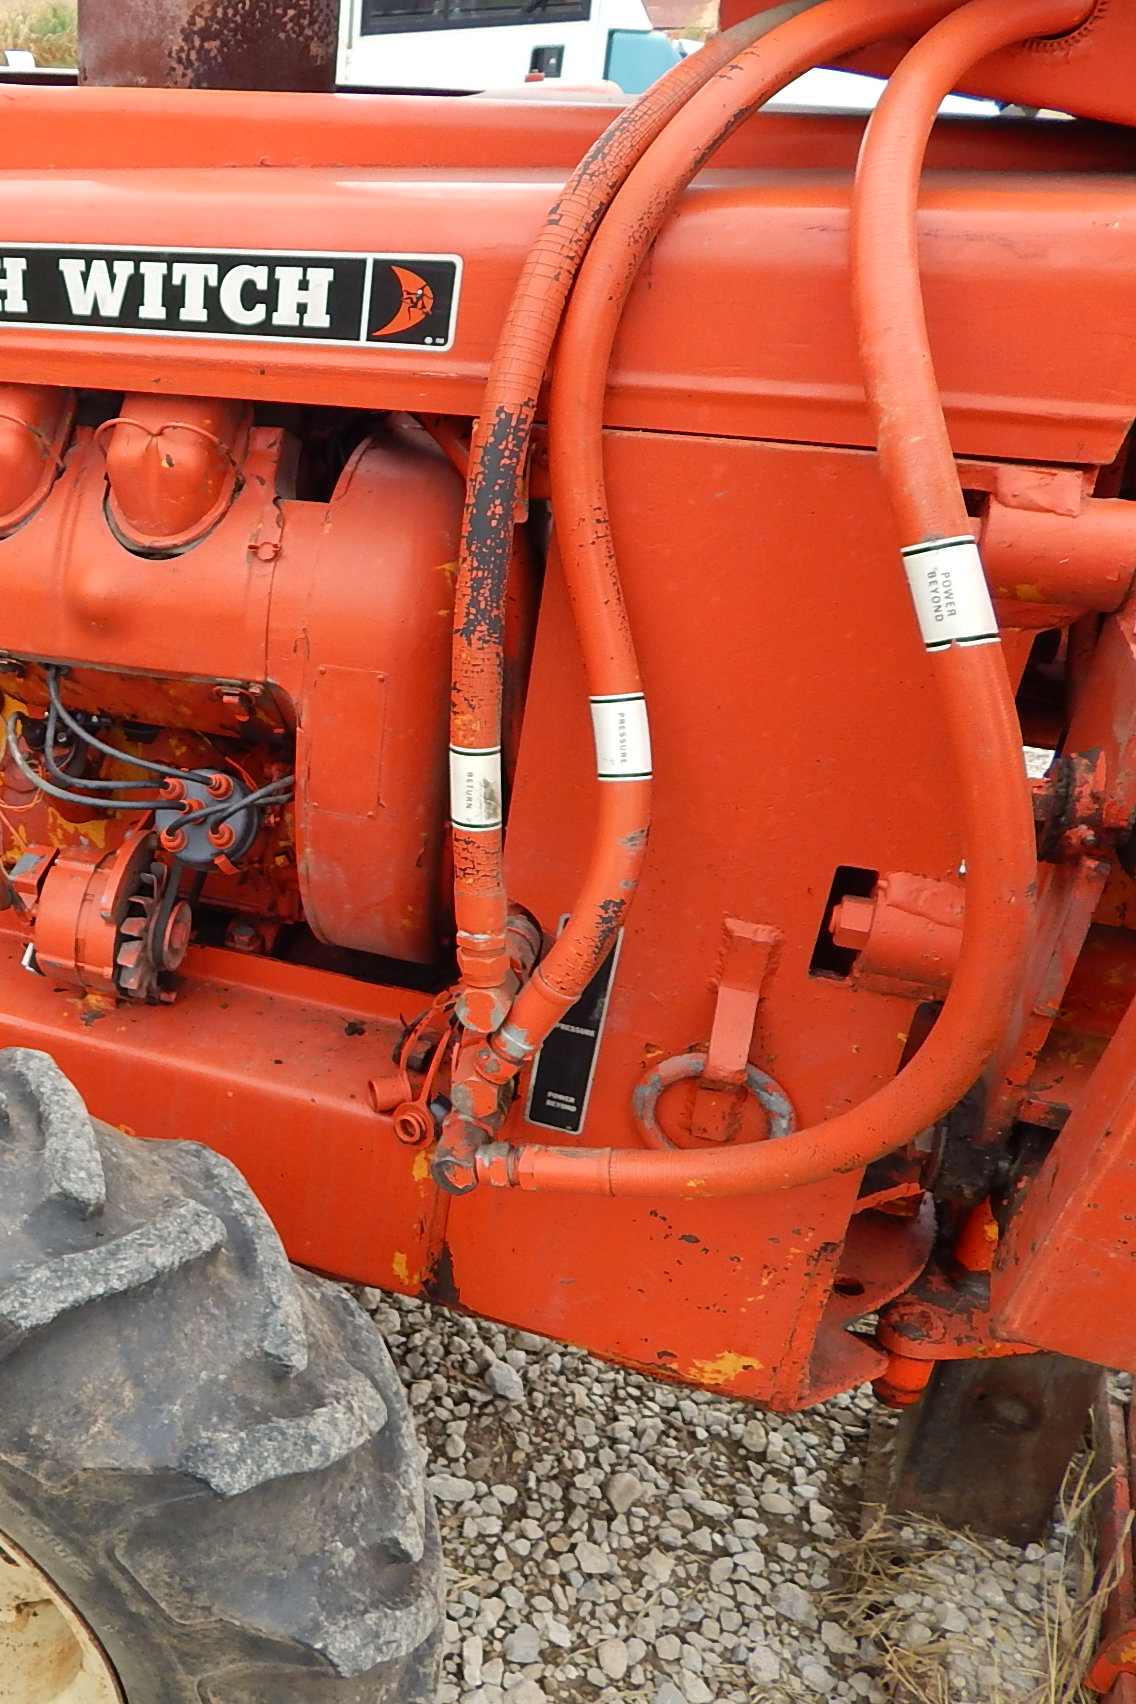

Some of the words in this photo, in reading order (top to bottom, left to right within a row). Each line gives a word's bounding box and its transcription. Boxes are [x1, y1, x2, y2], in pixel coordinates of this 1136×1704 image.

[59, 257, 335, 329] WITCH
[927, 571, 944, 622] BEYOND
[941, 571, 957, 617] POWER
[618, 712, 628, 764] PRESSURE
[465, 772, 474, 809] RETURN
